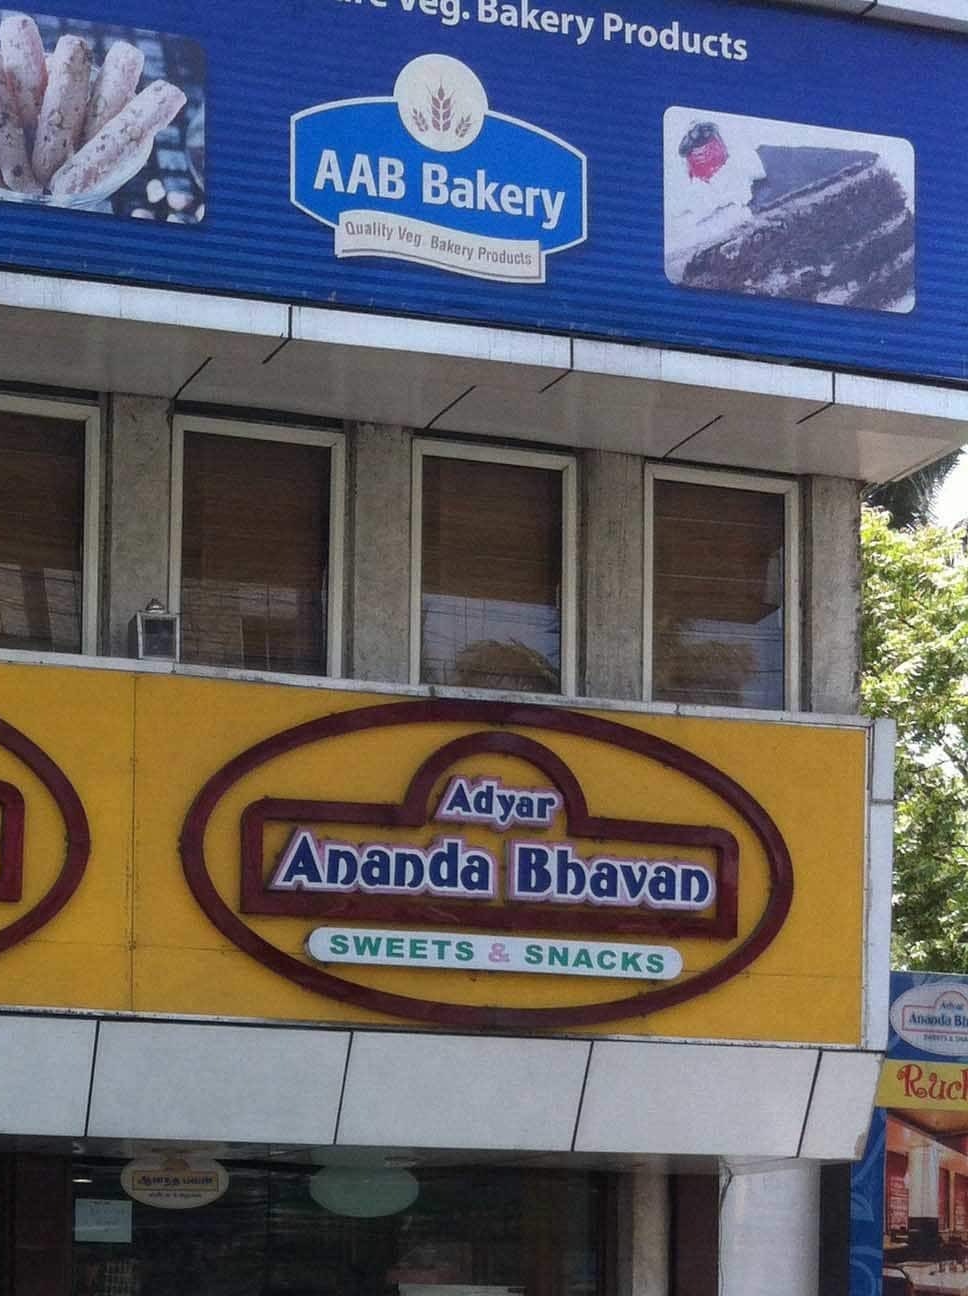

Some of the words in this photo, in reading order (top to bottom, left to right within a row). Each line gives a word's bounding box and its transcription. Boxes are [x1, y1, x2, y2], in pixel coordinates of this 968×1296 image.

[478, 0, 594, 45] Bakery
[603, 12, 749, 61] Products
[313, 149, 406, 200] AAB
[422, 162, 566, 230] Bakery
[345, 220, 394, 244] Quality
[431, 234, 473, 260] Bakery
[478, 246, 532, 266] Products
[446, 783, 555, 822] Adyar
[282, 835, 489, 891] Ananda
[517, 847, 710, 903] Bhavan
[330, 934, 474, 961] SWEETS
[488, 943, 510, 963] &
[524, 944, 665, 974] SNACKS
